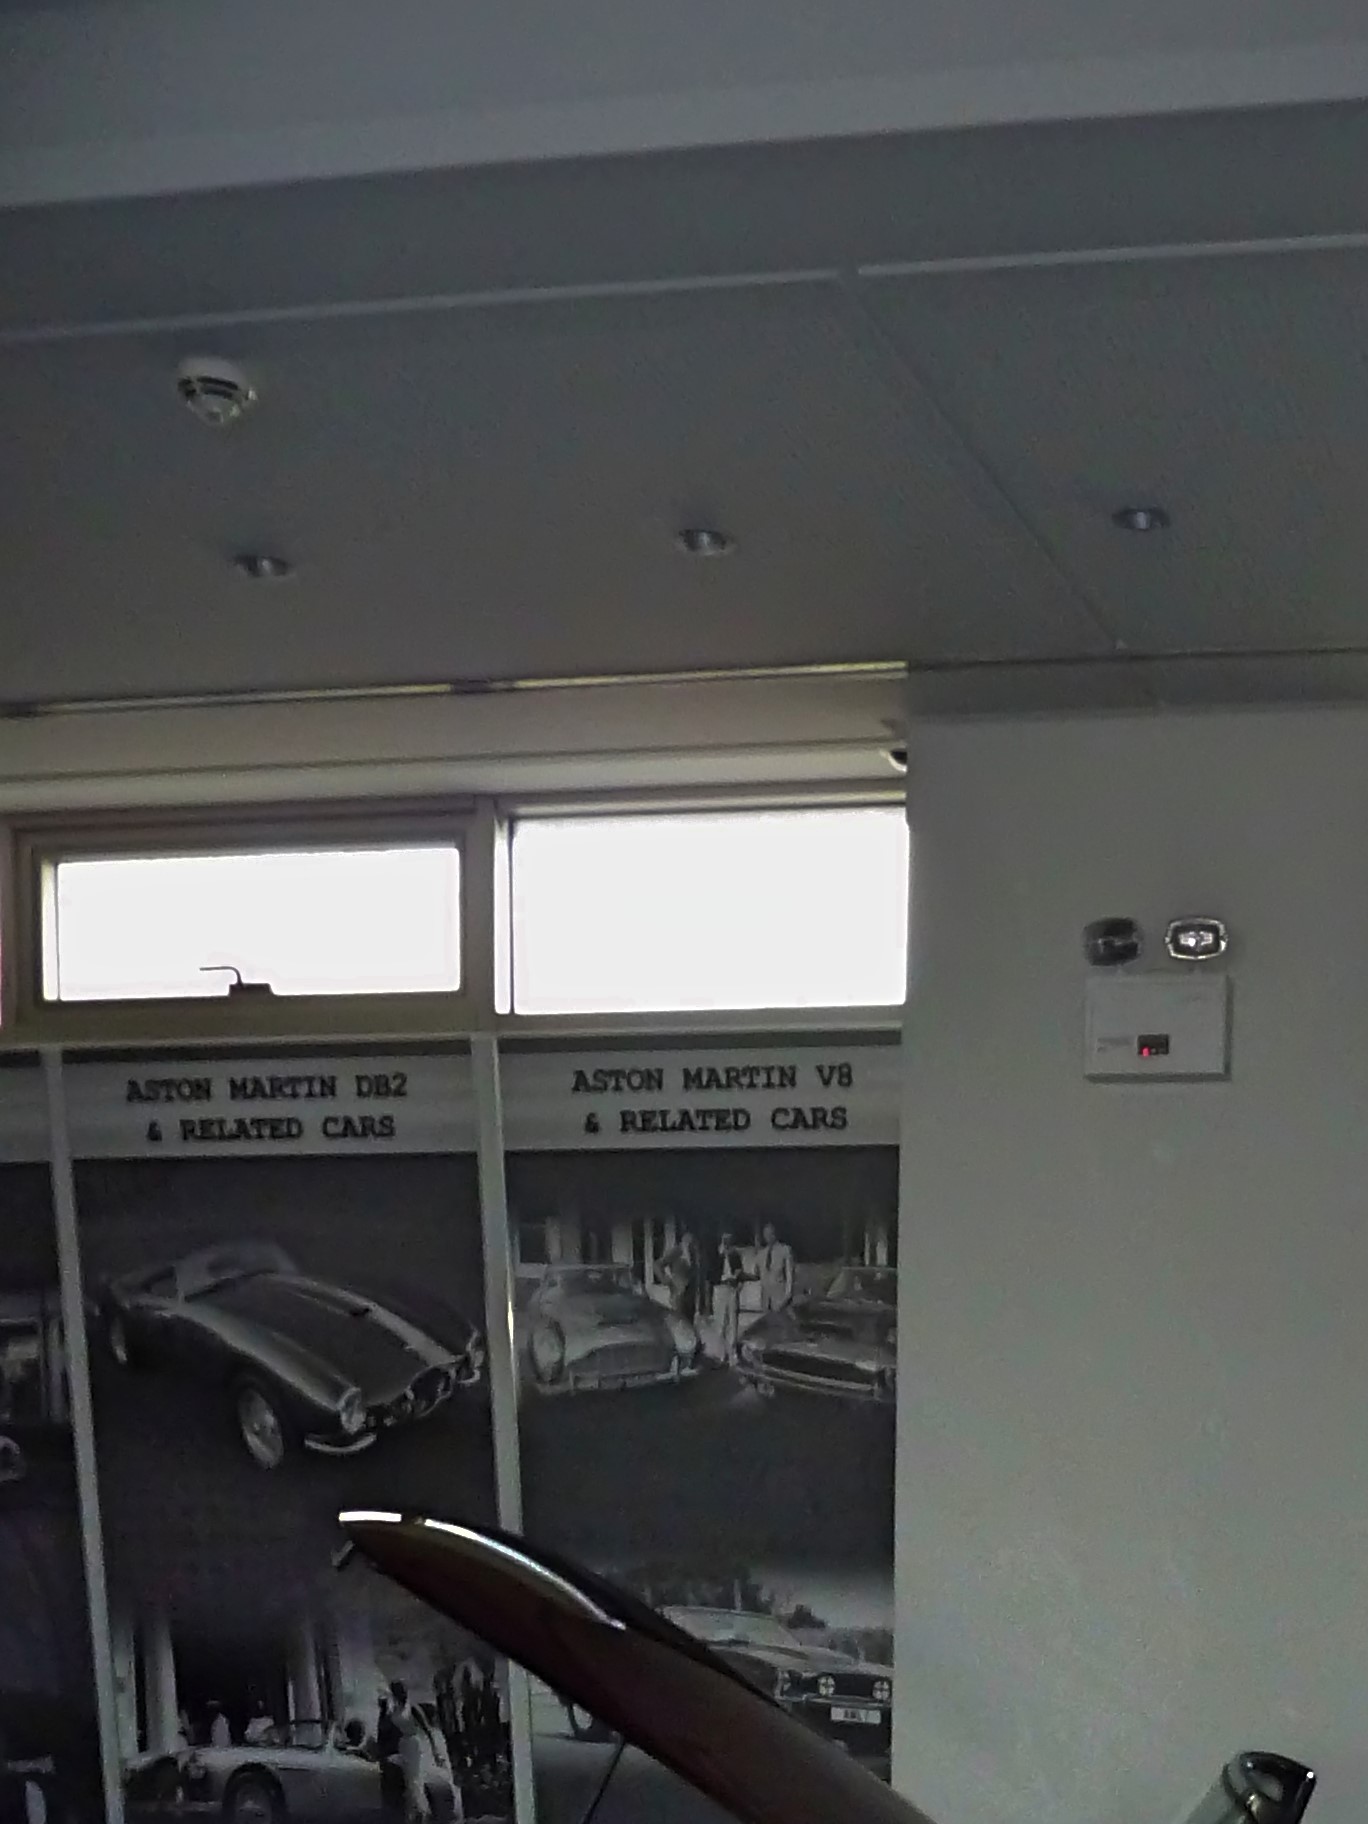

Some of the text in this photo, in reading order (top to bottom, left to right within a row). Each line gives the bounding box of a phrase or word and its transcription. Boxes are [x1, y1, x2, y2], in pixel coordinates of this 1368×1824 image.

[127, 1072, 407, 1101] ASTON MARTIN DB2
[573, 1063, 852, 1092] ASTON MARTIN V8
[180, 1117, 303, 1140] RELATED
[322, 1115, 394, 1138] CARS
[585, 1107, 848, 1133] & RELATED CARS
